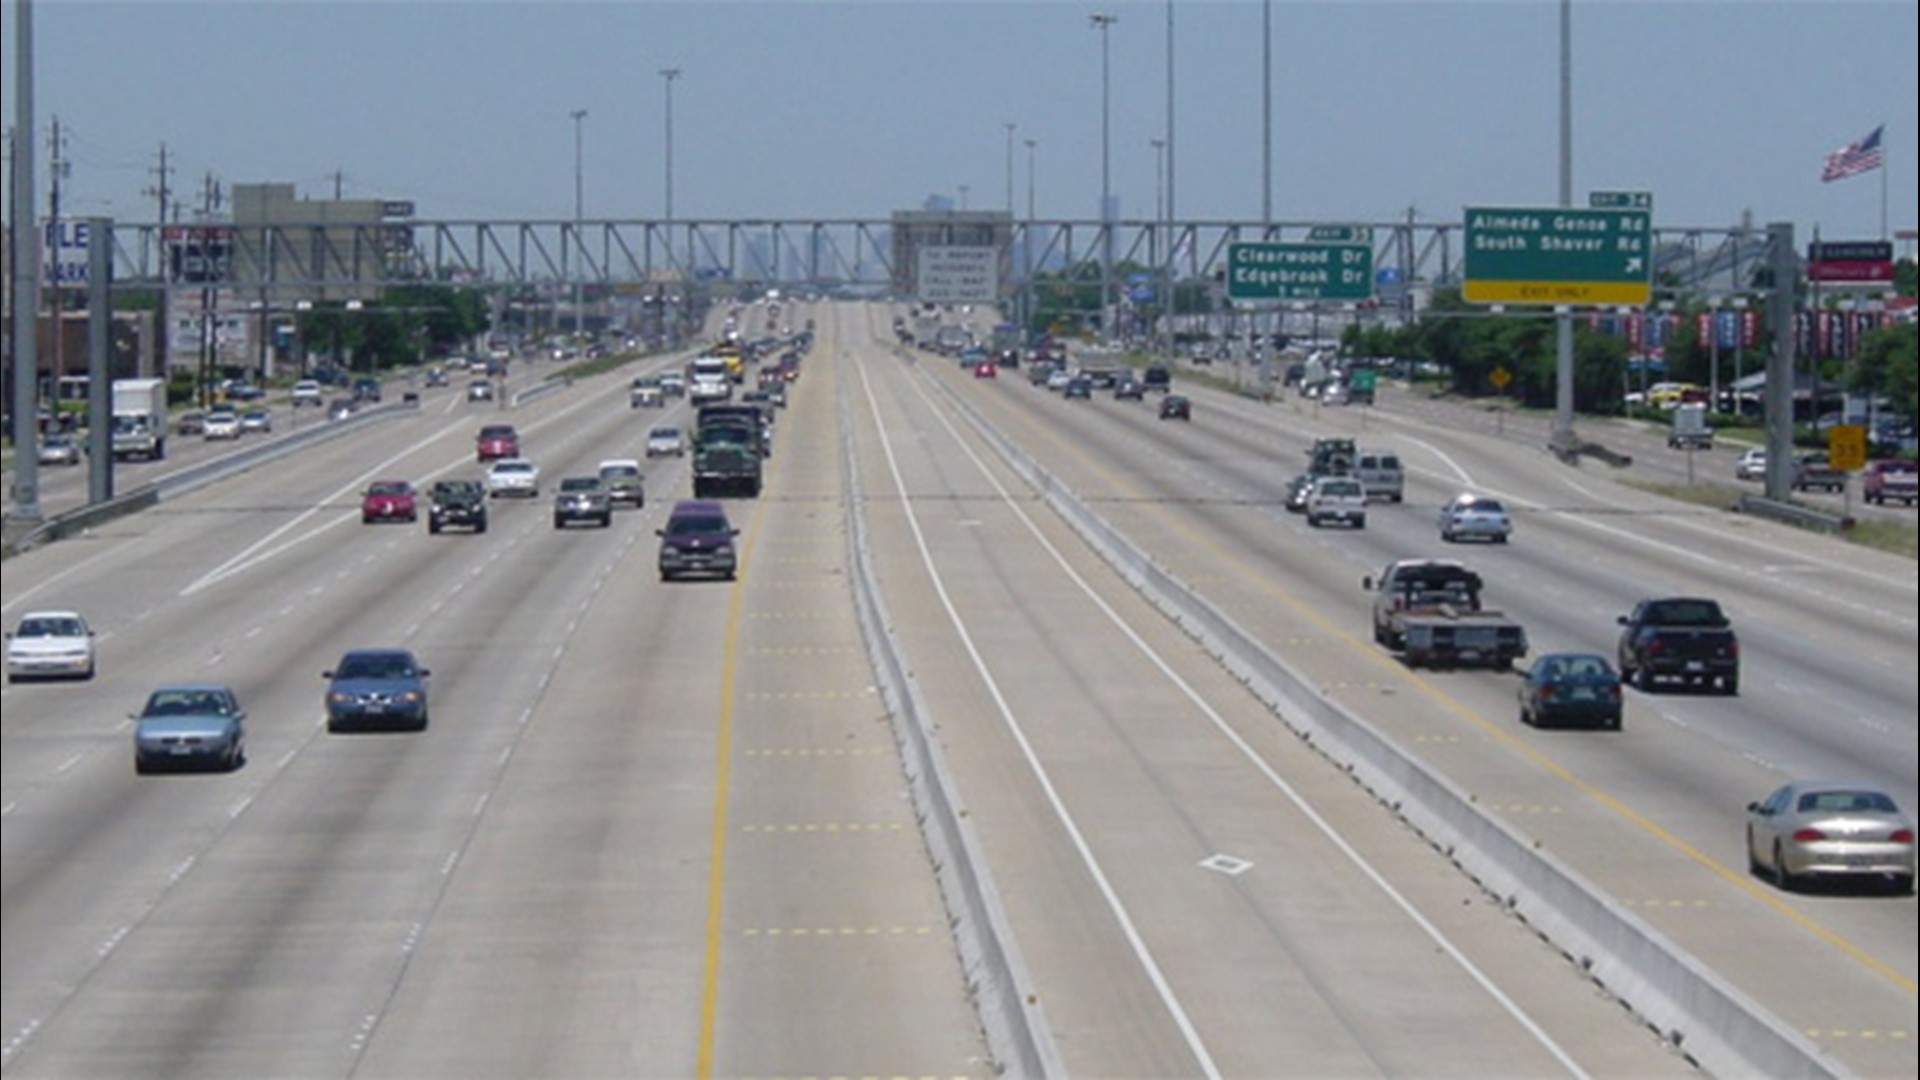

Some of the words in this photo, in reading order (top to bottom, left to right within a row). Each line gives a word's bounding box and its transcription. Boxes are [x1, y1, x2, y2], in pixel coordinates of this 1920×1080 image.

[1628, 192, 1648, 204] 34
[1472, 214, 1541, 230] Almeda
[1553, 216, 1607, 231] Genoa
[1620, 216, 1644, 231] Rd
[1475, 234, 1527, 249] South
[1540, 236, 1605, 250] Shaver
[1617, 237, 1641, 251] Rd
[1236, 248, 1328, 263] Clearwood
[1342, 249, 1364, 264] Dr
[1235, 267, 1328, 288] Edgebrook
[1342, 268, 1364, 283] Dr
[1520, 286, 1549, 297] EXIT
[1555, 286, 1590, 297] ONLY
